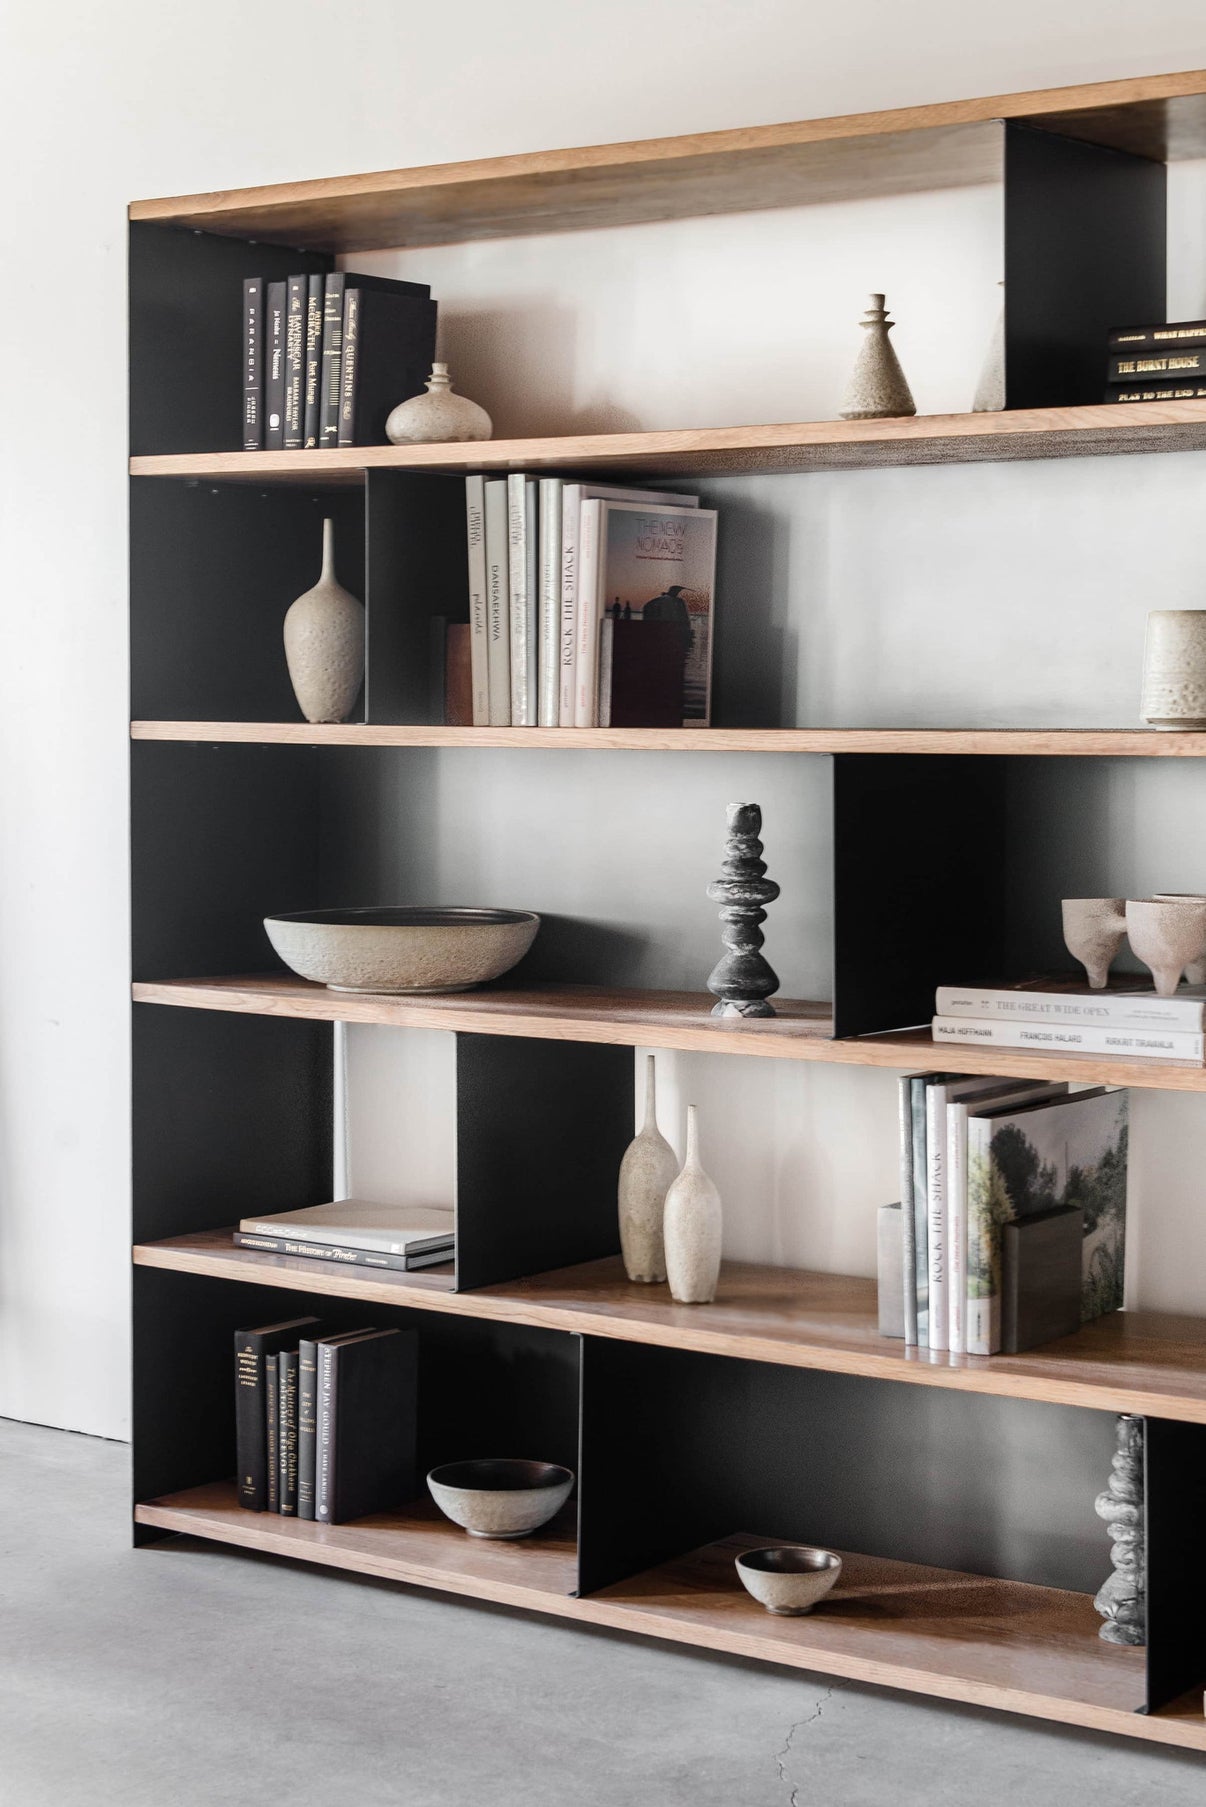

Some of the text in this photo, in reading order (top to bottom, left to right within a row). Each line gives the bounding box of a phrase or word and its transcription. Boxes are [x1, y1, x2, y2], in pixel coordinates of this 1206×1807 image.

[292, 315, 302, 371] RAVENSCAR
[345, 345, 354, 397] QUENTINS
[1118, 361, 1136, 373] THE
[1168, 356, 1199, 369] HOUSE
[1156, 390, 1174, 399] THE
[635, 518, 660, 536] THE
[491, 564, 500, 642] DANSAEKHWA
[563, 546, 574, 666] ROCK THE SHACK
[996, 1000, 1017, 1011] THE
[1018, 1002, 1052, 1014] GREAT
[1053, 1004, 1082, 1016] WIDE
[1082, 1007, 1111, 1017] OPEN
[931, 1152, 943, 1284] ROCK THE SHACK
[287, 1367, 297, 1383] The
[324, 1347, 332, 1390] STEPHEN
[280, 1378, 288, 1426] ANTONY
[285, 1384, 297, 1419] Mystery
[322, 1390, 331, 1408] JAY
[284, 1419, 297, 1430] of
[285, 1431, 298, 1451] Olga
[321, 1411, 331, 1445] GOULD
